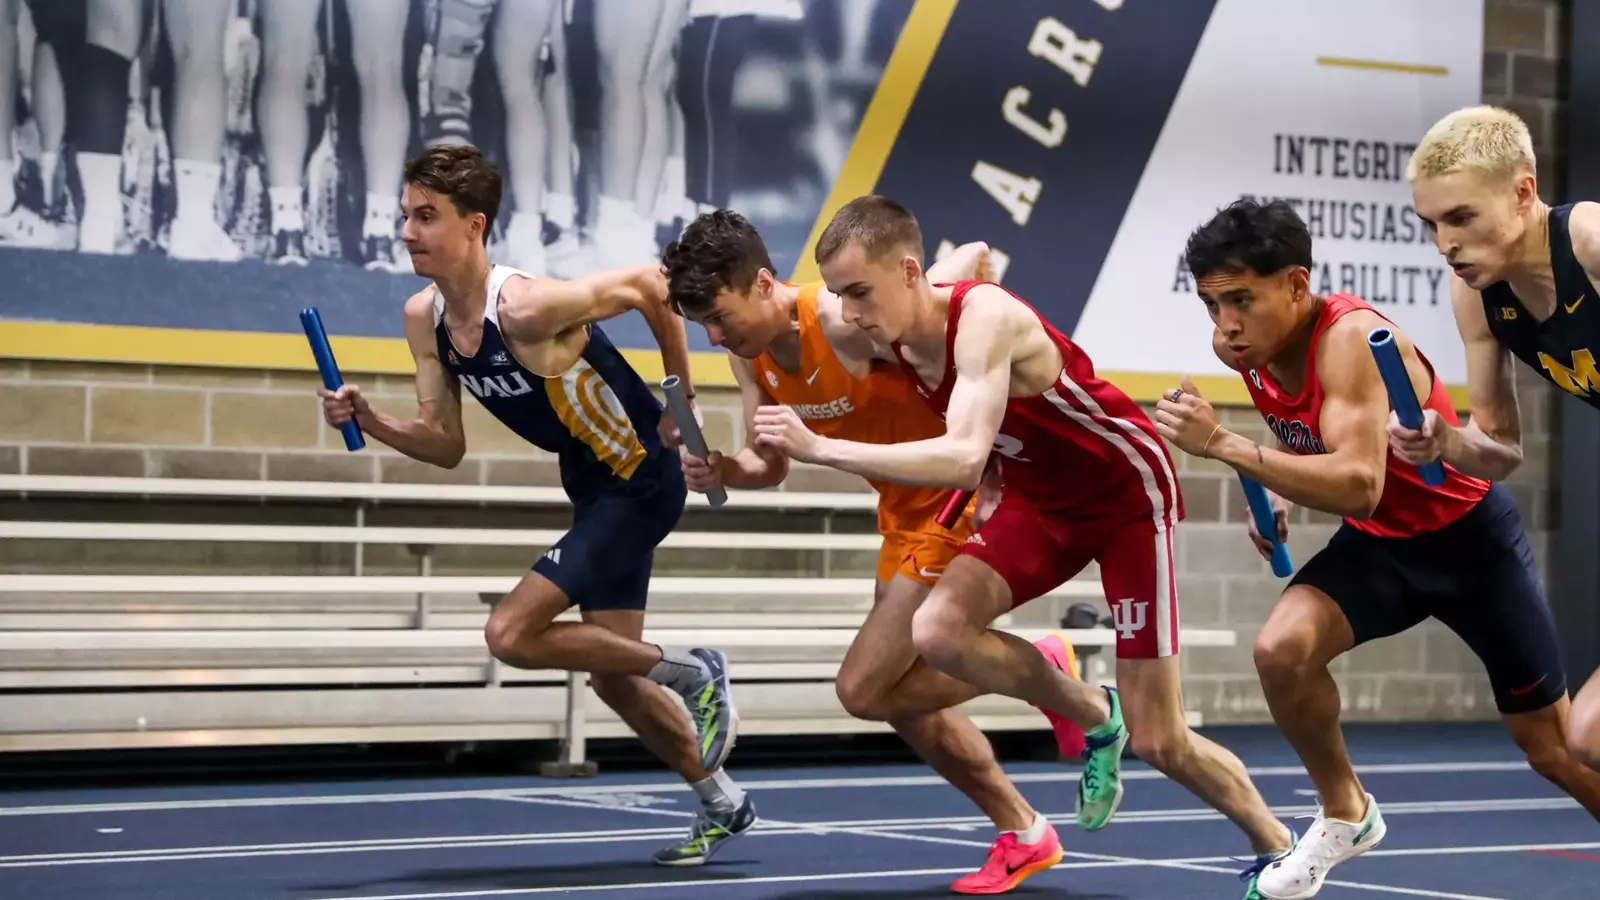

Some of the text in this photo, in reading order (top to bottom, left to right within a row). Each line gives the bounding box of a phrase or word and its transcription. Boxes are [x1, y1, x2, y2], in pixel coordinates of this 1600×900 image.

[1274, 134, 1420, 181] INTEGRI
[1238, 194, 1430, 244] HUSIAS
[458, 370, 533, 398] NAU
[1537, 347, 1600, 397] M
[791, 396, 855, 420] NESSEE
